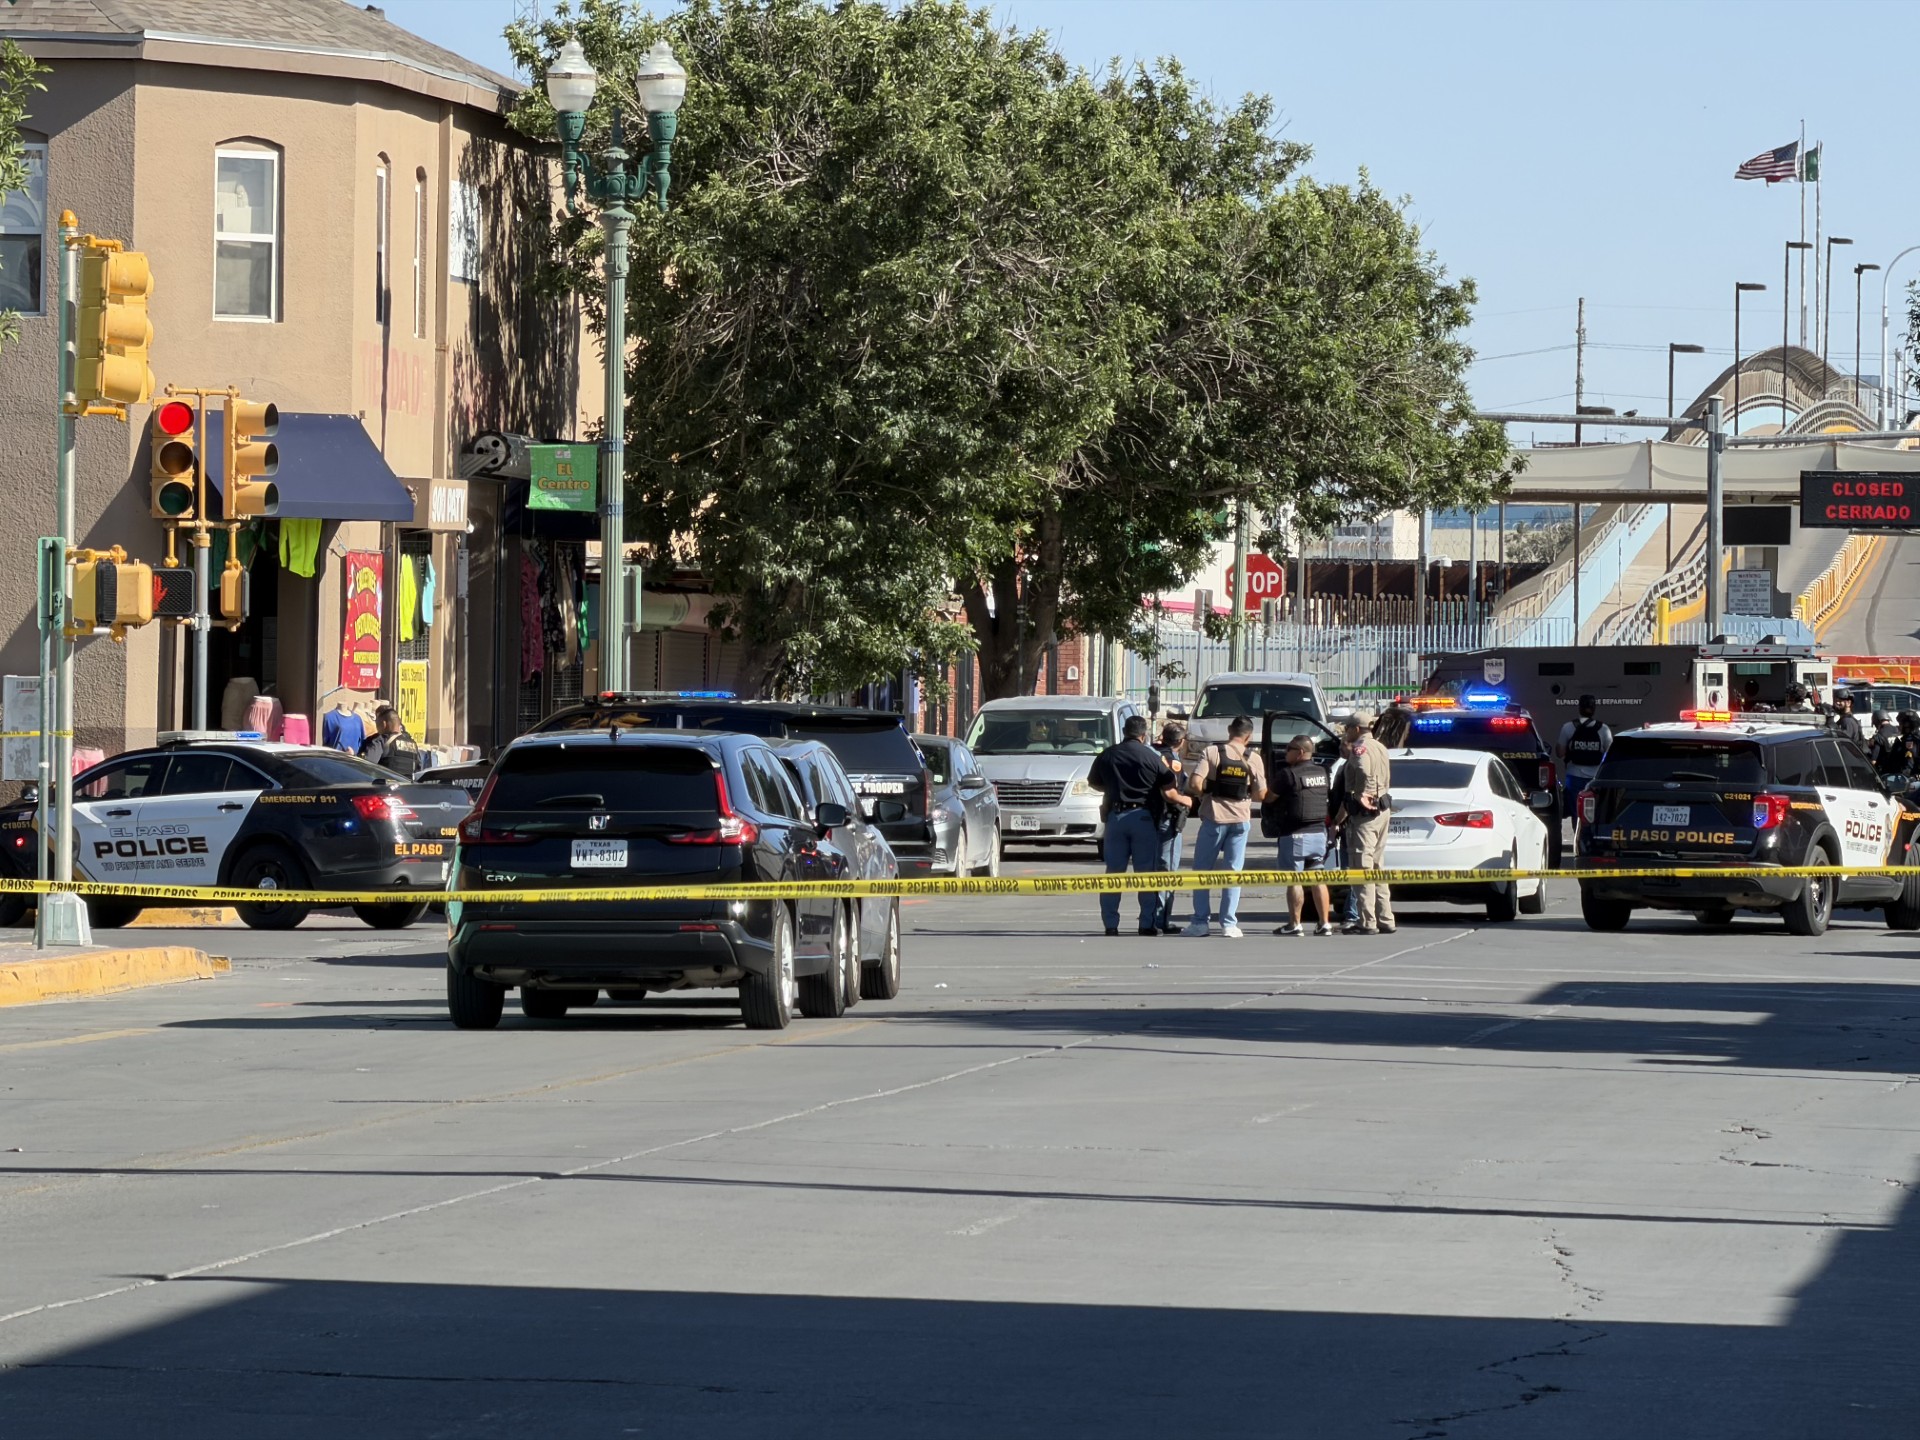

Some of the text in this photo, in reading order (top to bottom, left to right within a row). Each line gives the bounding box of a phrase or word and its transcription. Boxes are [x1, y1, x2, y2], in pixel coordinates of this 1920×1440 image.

[556, 463, 573, 476] El
[537, 477, 592, 491] Centro
[1832, 482, 1904, 496] CLOSED
[447, 488, 465, 523] PATY
[1825, 504, 1911, 520] CERRADO
[1230, 571, 1280, 593] TOP
[401, 688, 418, 724] PATY
[863, 782, 904, 793] TROOPER
[1305, 776, 1327, 787] POLICE
[259, 795, 337, 804] EMERGENCY 911
[109, 824, 190, 838] EL PASO
[1611, 829, 1735, 845] EL PASO POLICE
[1845, 820, 1882, 842] POLICE
[93, 836, 209, 859] POLICE
[394, 844, 443, 856] EL PASO
[101, 858, 206, 872] TO PROTECT AND SERVE
[0, 879, 35, 891] CROSS
[486, 874, 517, 882] CR-V
[49, 882, 84, 892] CRIME
[87, 884, 120, 894] SCENE
[141, 887, 161, 896] NOT
